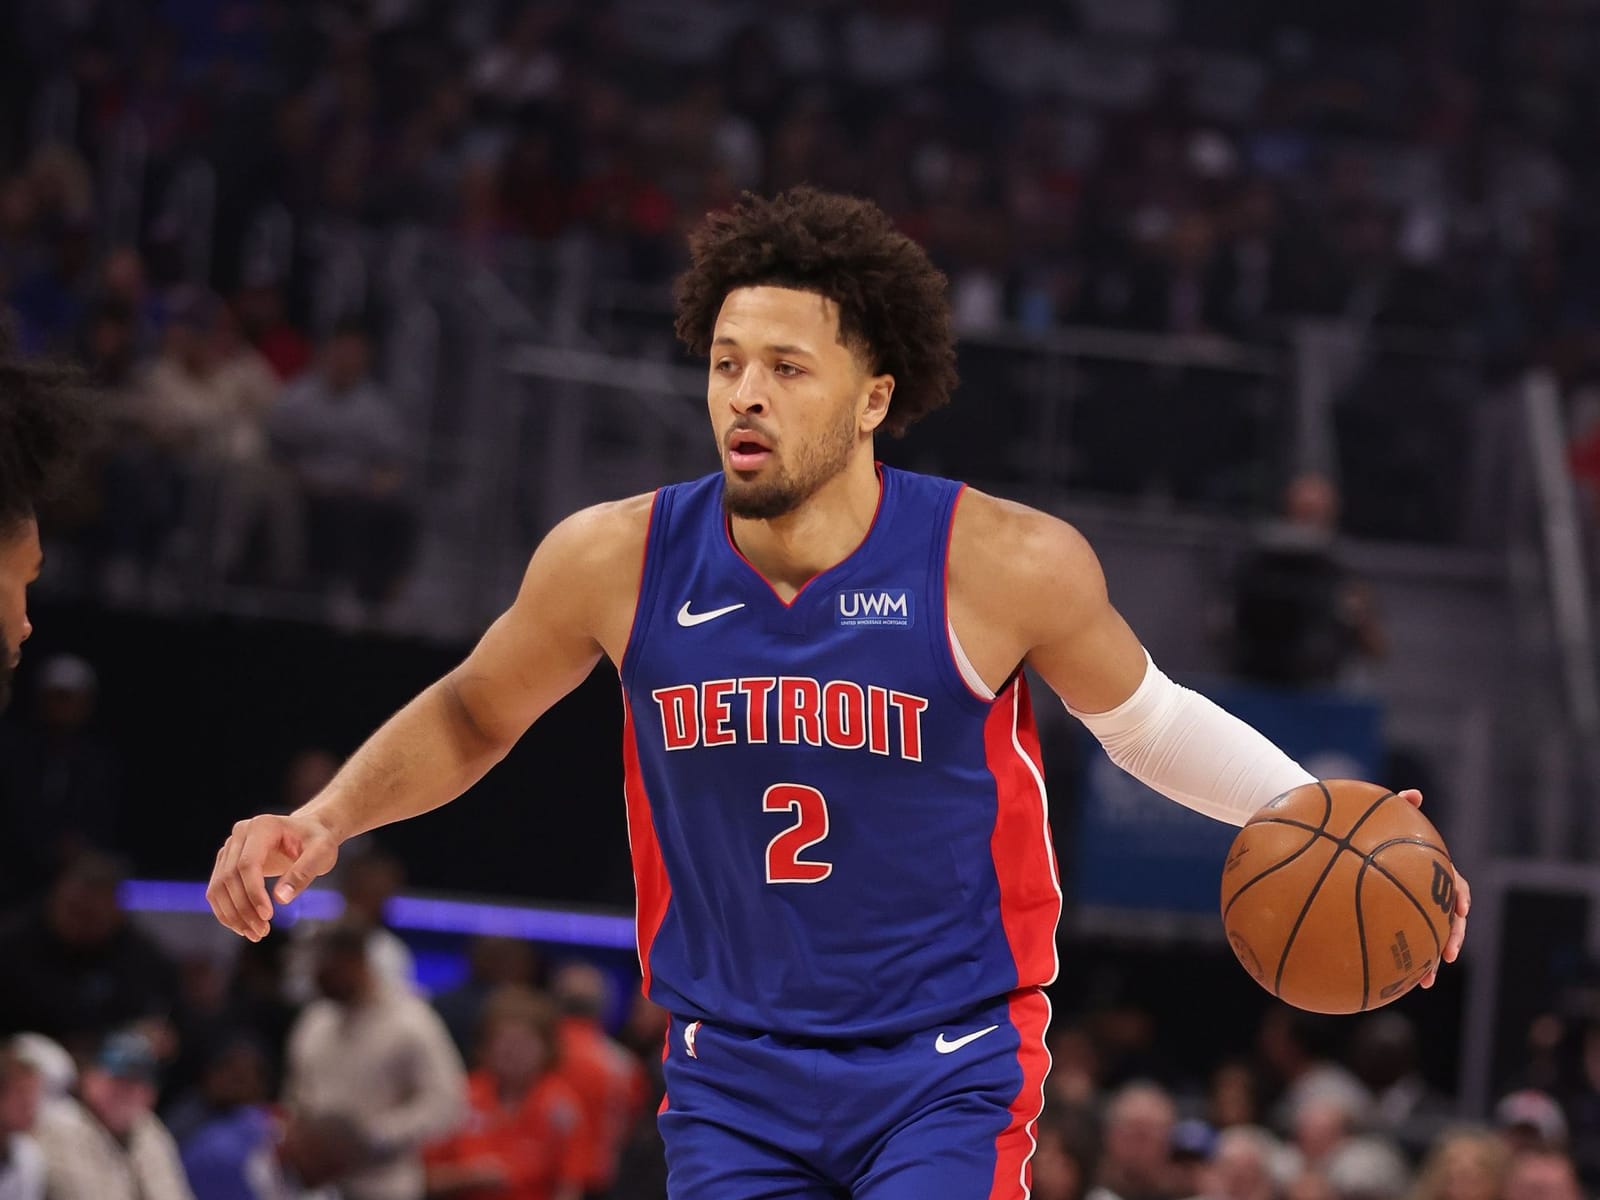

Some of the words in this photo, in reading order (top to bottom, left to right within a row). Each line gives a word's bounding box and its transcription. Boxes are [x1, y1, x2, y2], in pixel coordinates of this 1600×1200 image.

[840, 593, 907, 617] UWM
[652, 676, 929, 762] DETROIT
[763, 783, 833, 884] 2
